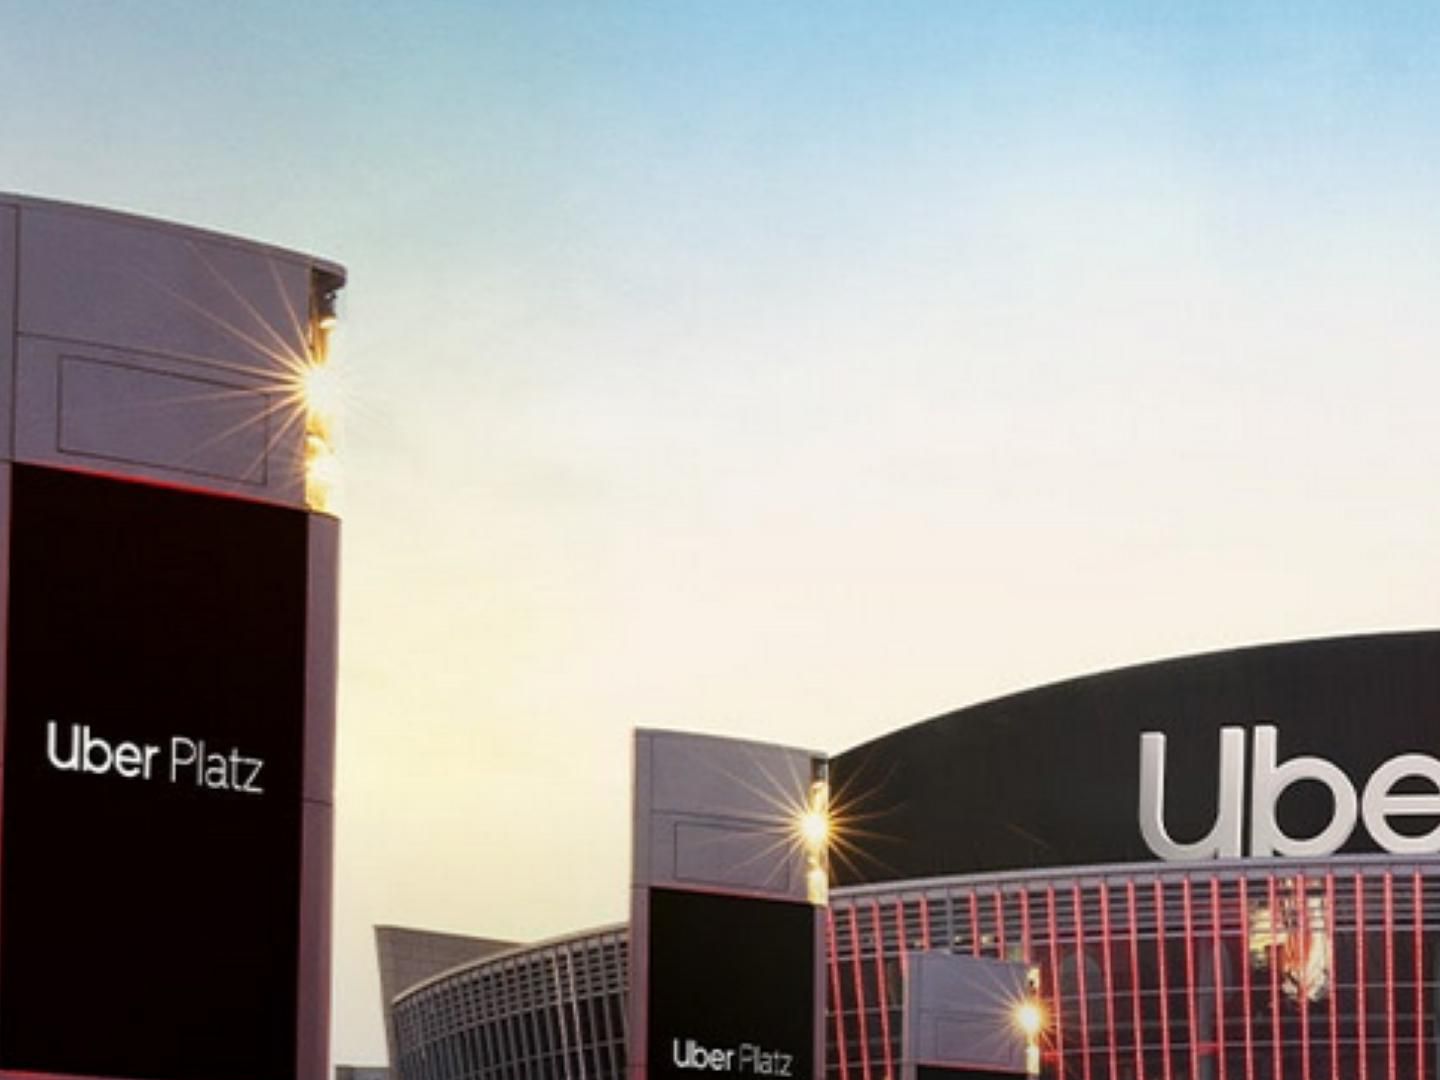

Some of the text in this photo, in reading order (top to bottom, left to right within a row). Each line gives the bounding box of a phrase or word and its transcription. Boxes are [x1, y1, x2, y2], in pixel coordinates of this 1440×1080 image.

[47, 720, 264, 794] Uber Platz
[673, 1037, 793, 1077] Uber Platz
